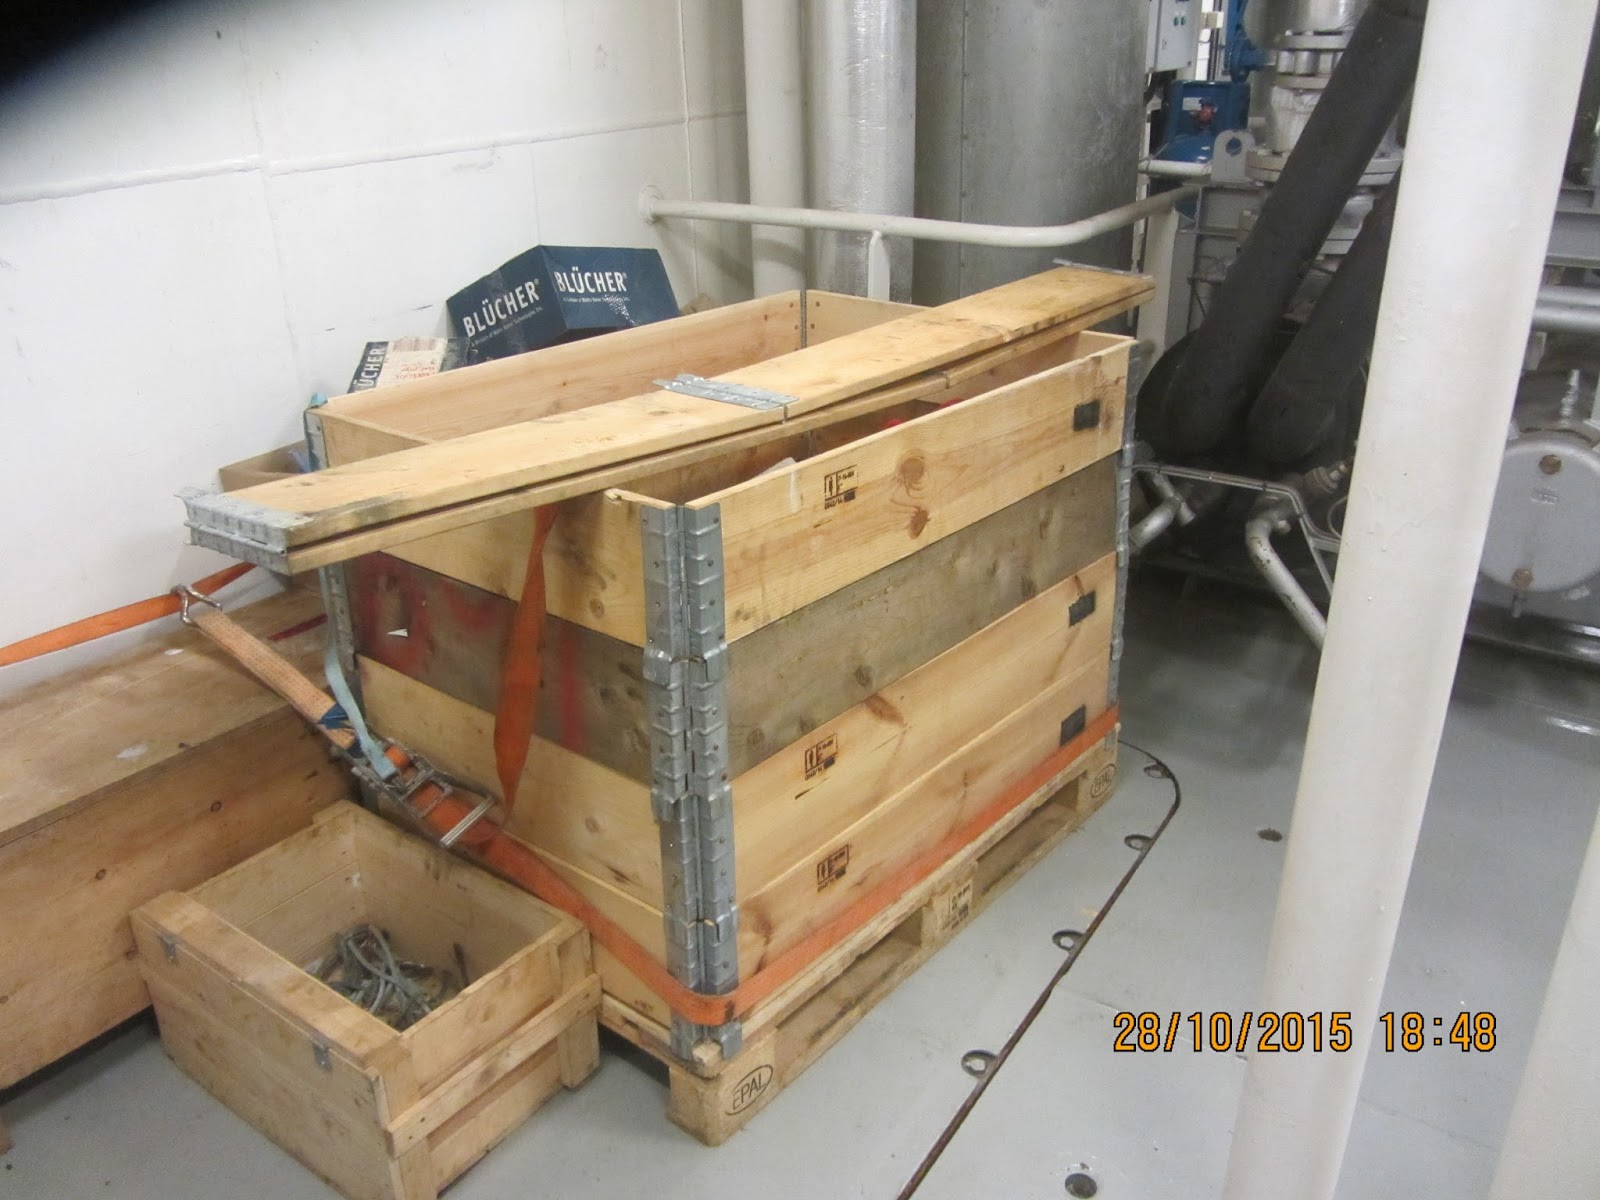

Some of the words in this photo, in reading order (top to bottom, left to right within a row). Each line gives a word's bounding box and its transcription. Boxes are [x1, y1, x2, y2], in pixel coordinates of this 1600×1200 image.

[554, 266, 627, 293] BLÜCHER
[462, 280, 540, 338] BLÜCHER
[353, 348, 386, 387] ÜCHER
[732, 1072, 767, 1111] EPAL
